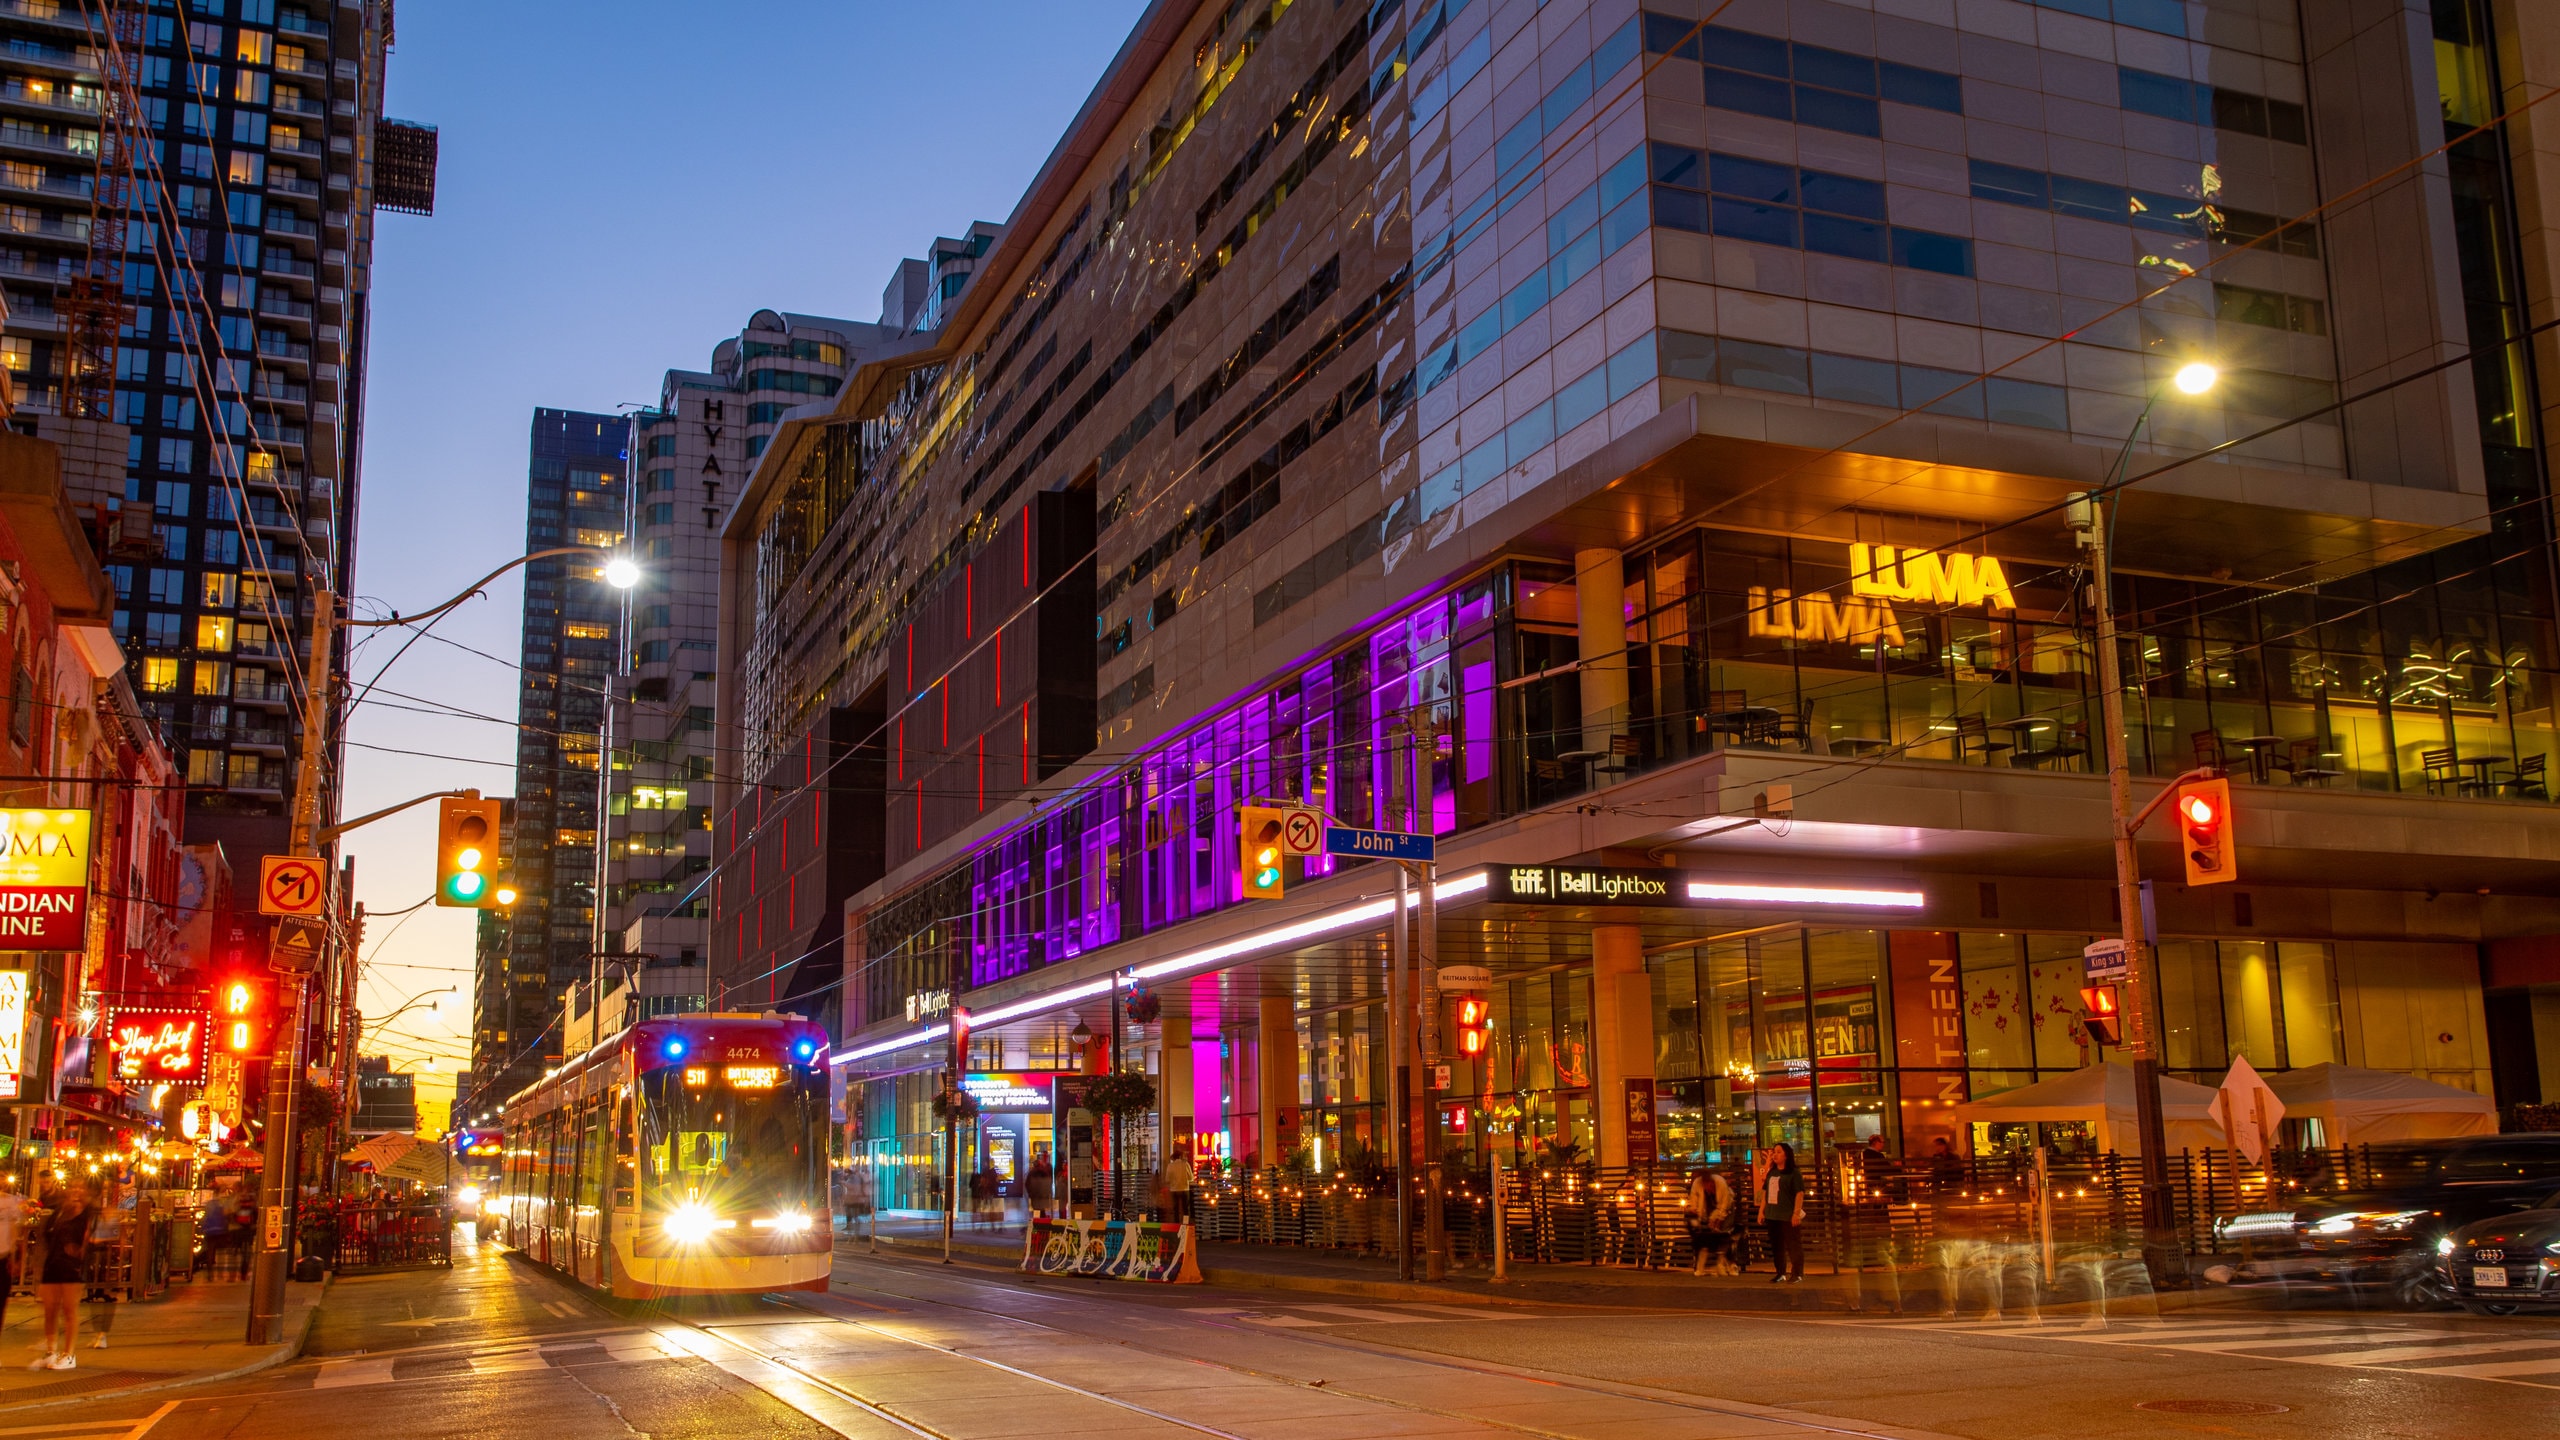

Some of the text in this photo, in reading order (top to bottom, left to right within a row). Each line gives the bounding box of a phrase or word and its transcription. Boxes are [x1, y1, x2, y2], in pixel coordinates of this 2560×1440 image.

[702, 398, 723, 529] HYATT
[1850, 542, 2016, 611] LUMA
[1748, 586, 1905, 648] LUMA
[0, 832, 77, 858] MA
[1353, 831, 1409, 852] John St
[2091, 957, 2107, 968] King
[2115, 952, 2123, 963] W
[120, 1021, 196, 1056] Hey Lucy
[1928, 959, 1963, 1100] NTEEN
[727, 1047, 760, 1059] 4474
[687, 1066, 778, 1085] 511 BATHURST
